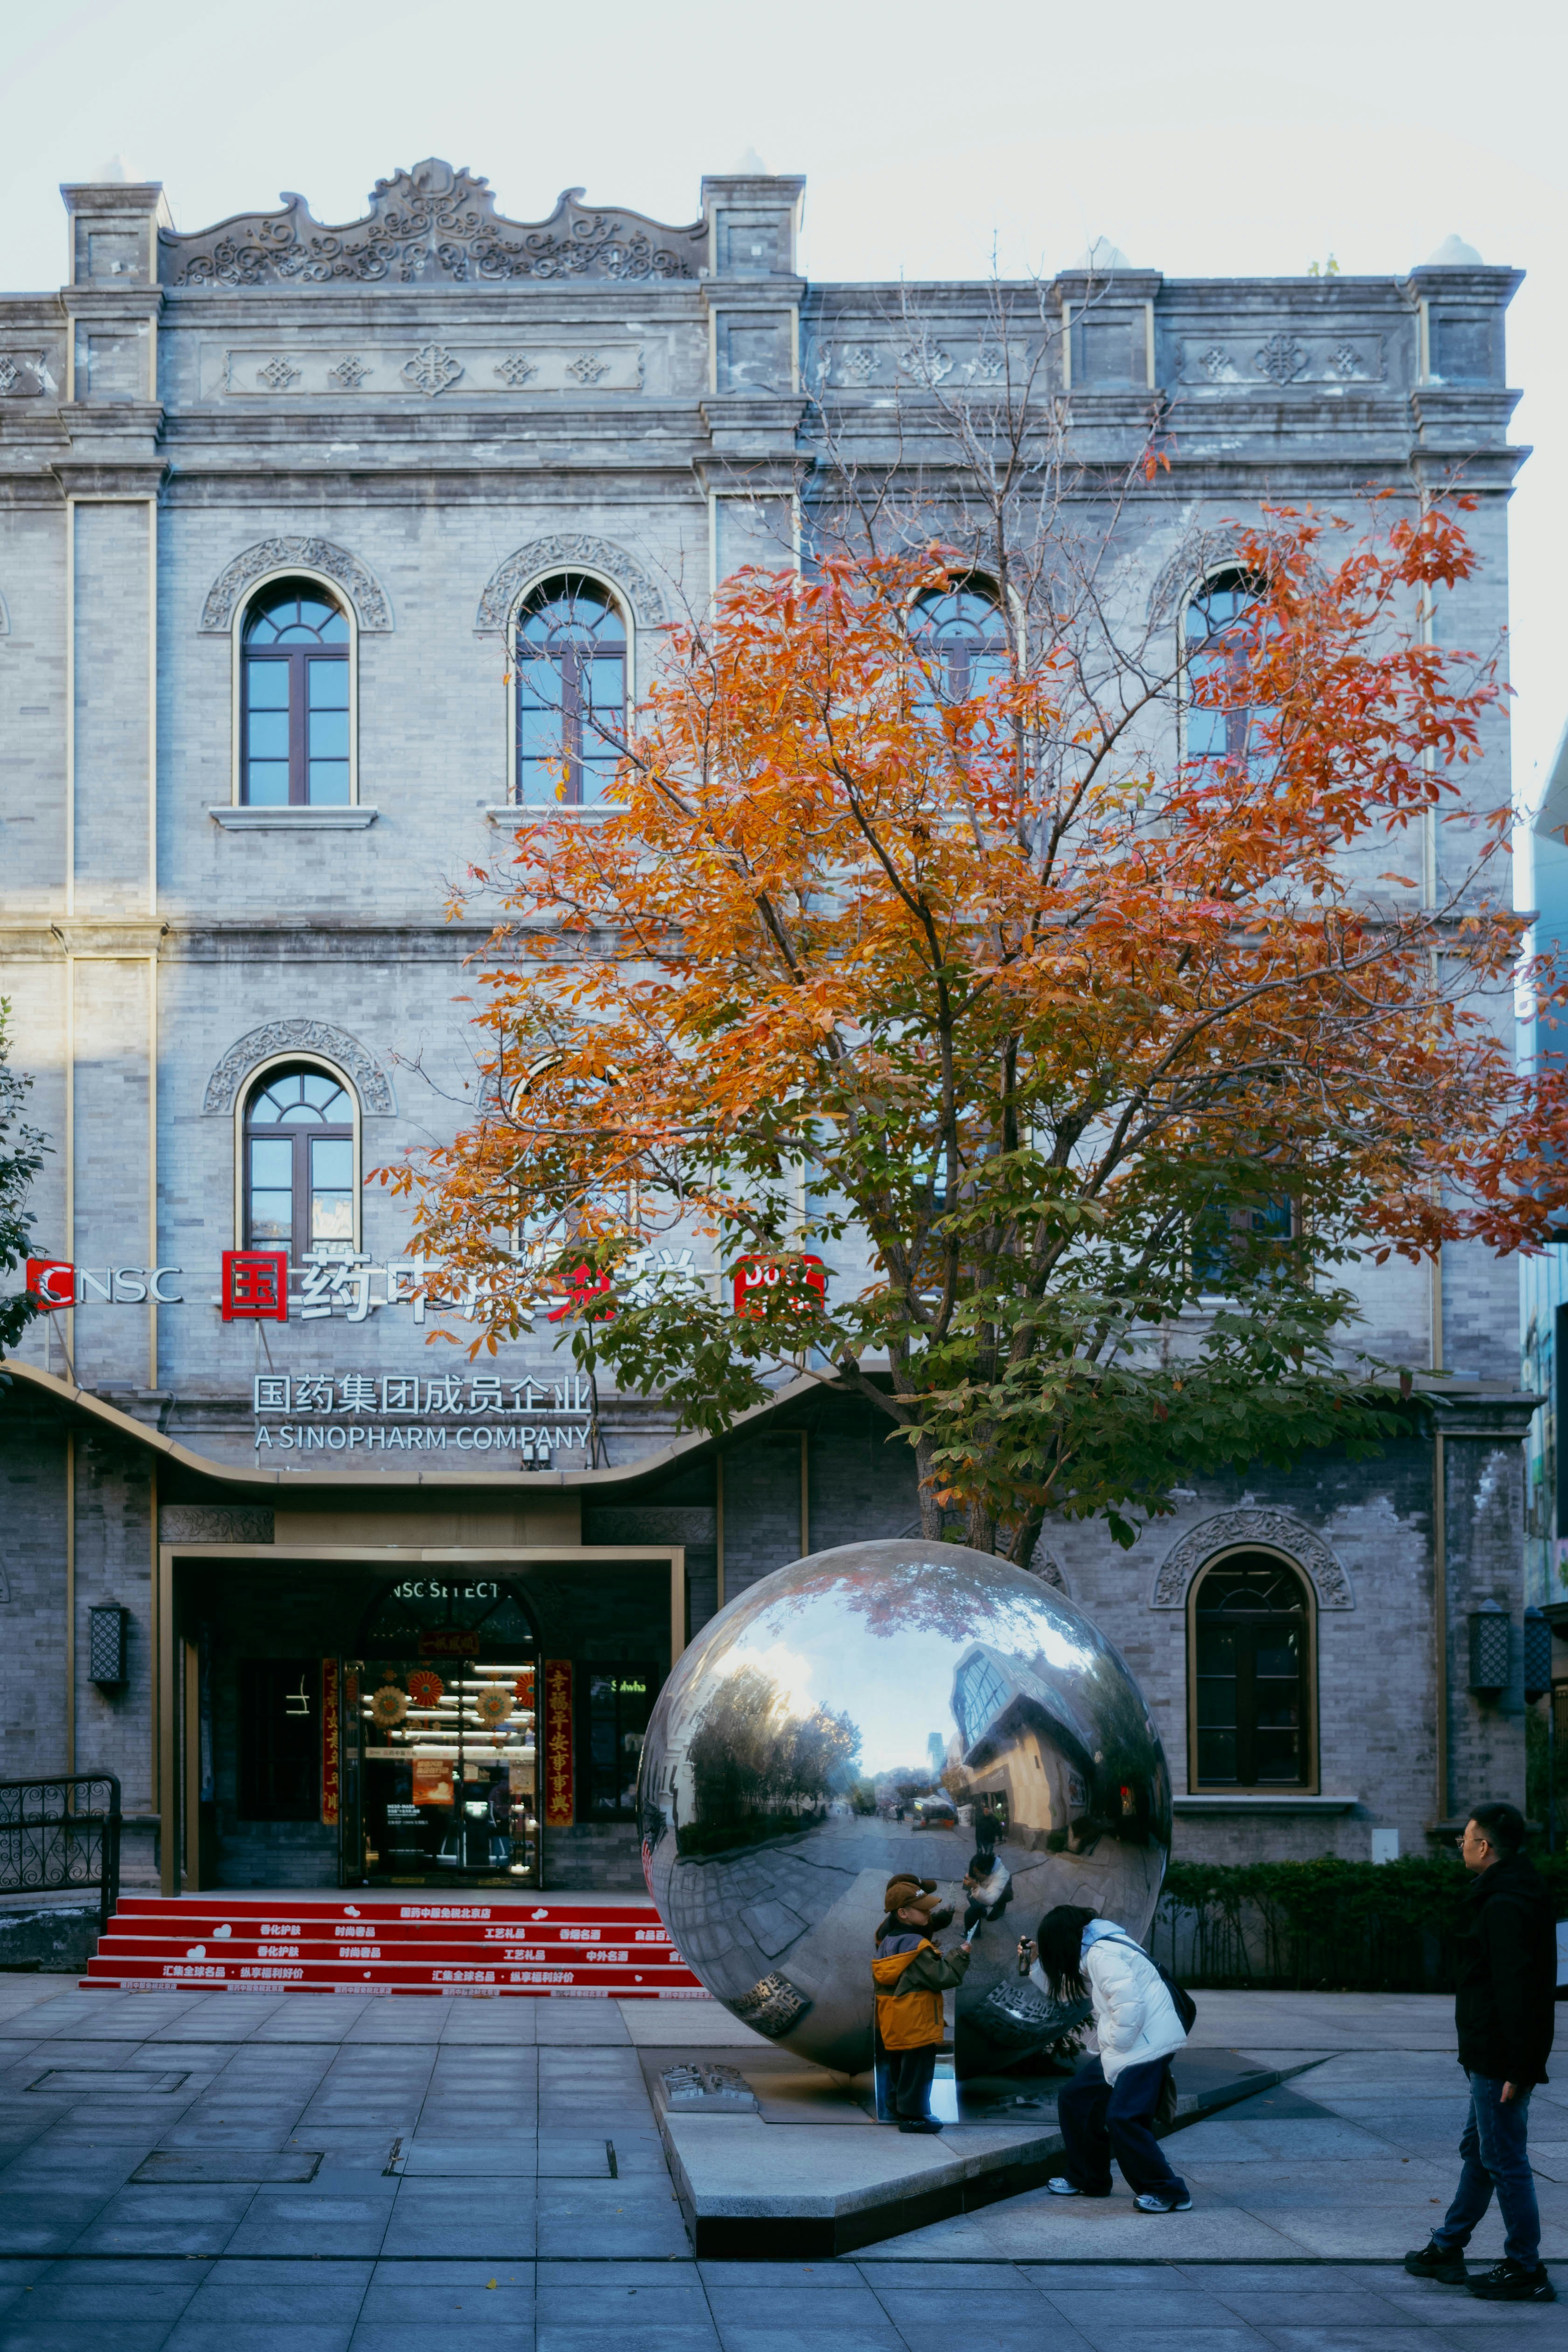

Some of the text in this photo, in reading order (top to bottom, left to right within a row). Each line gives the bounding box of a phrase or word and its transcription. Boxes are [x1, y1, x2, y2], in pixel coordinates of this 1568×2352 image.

[40, 1266, 182, 1304] CNSC
[254, 1373, 591, 1415] 国药集团成员企业
[255, 1425, 591, 1450] A SINOPHARM COMPANY
[390, 1582, 424, 1598] NSC
[401, 1907, 491, 1919] 国药中服免税北京店
[260, 1924, 301, 1935] 香化护肤
[335, 1926, 375, 1937] 时尚奢品
[484, 1928, 525, 1939] 工艺礼品
[560, 1929, 601, 1940] 香烟名酒
[257, 1945, 685, 1962] 香化护肤 时尚奢品 工艺礼品 中外名酒 食
